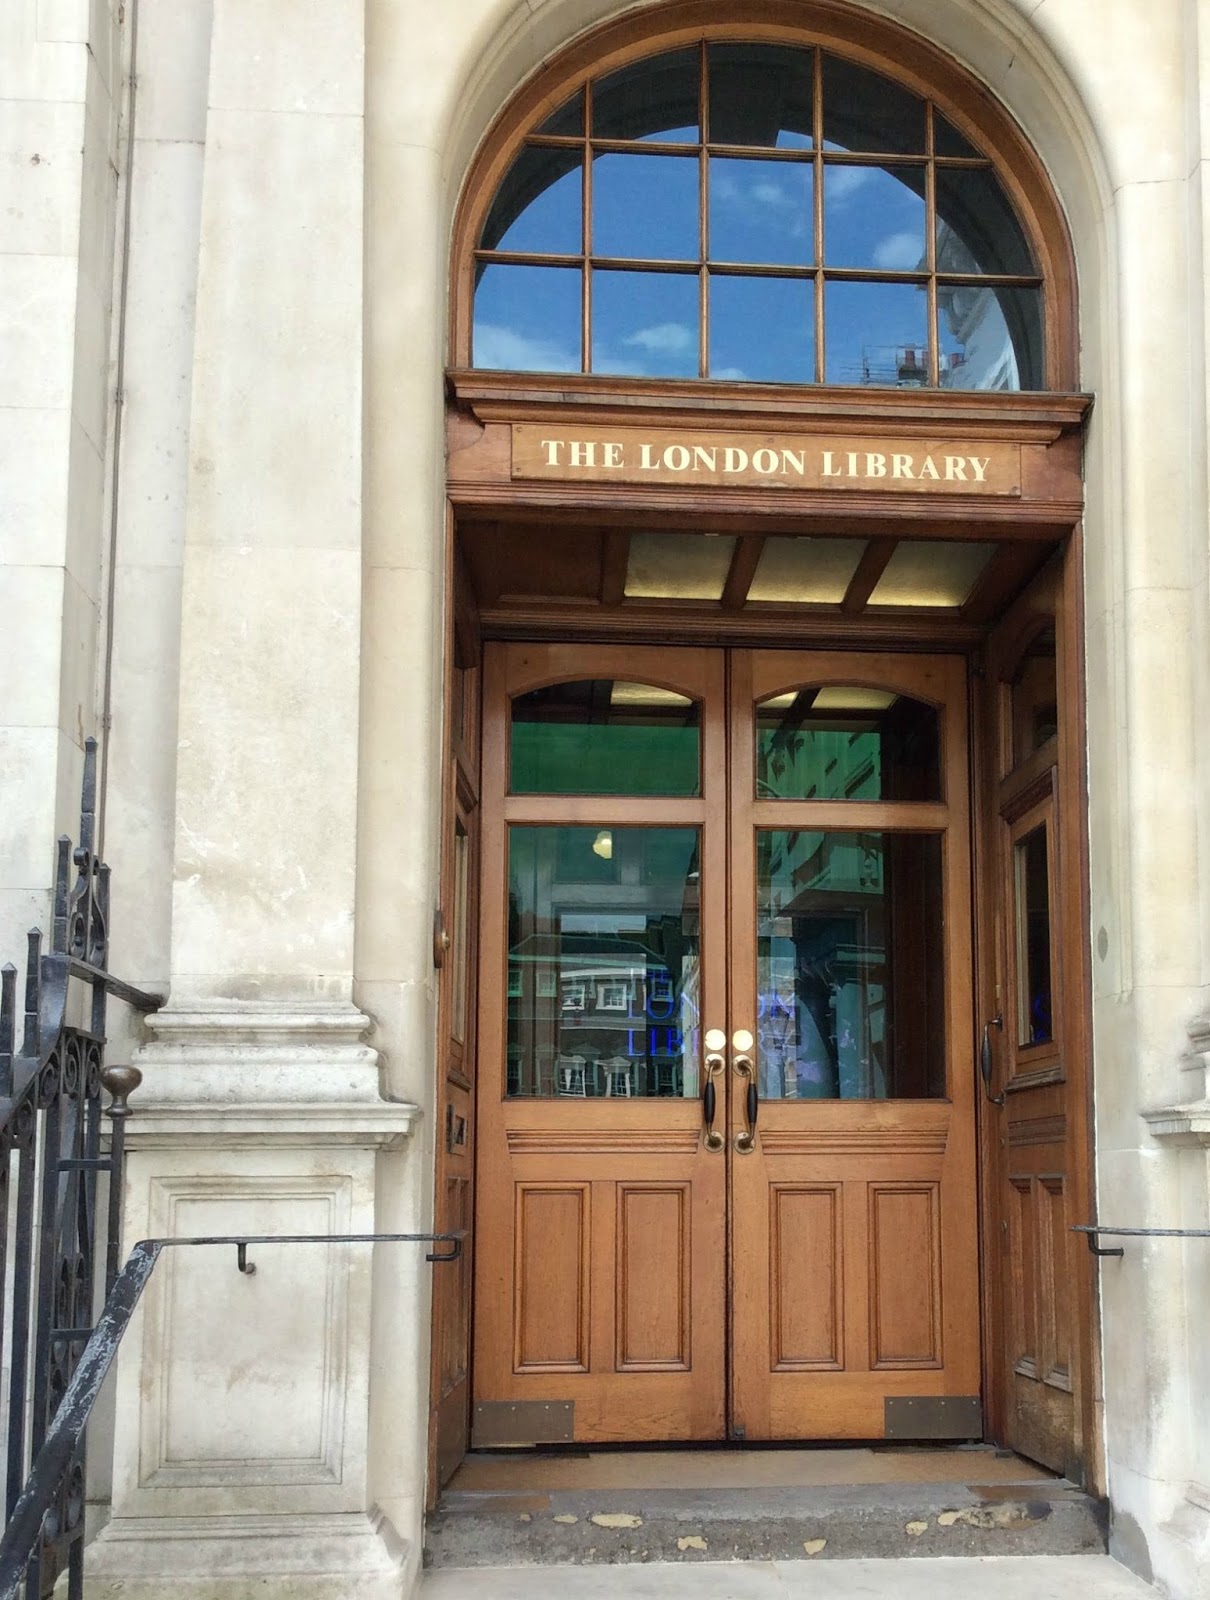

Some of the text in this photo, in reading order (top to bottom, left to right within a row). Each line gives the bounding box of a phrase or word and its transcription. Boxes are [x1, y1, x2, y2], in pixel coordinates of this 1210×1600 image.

[540, 439, 991, 483] THE LONDON LIBRARY
